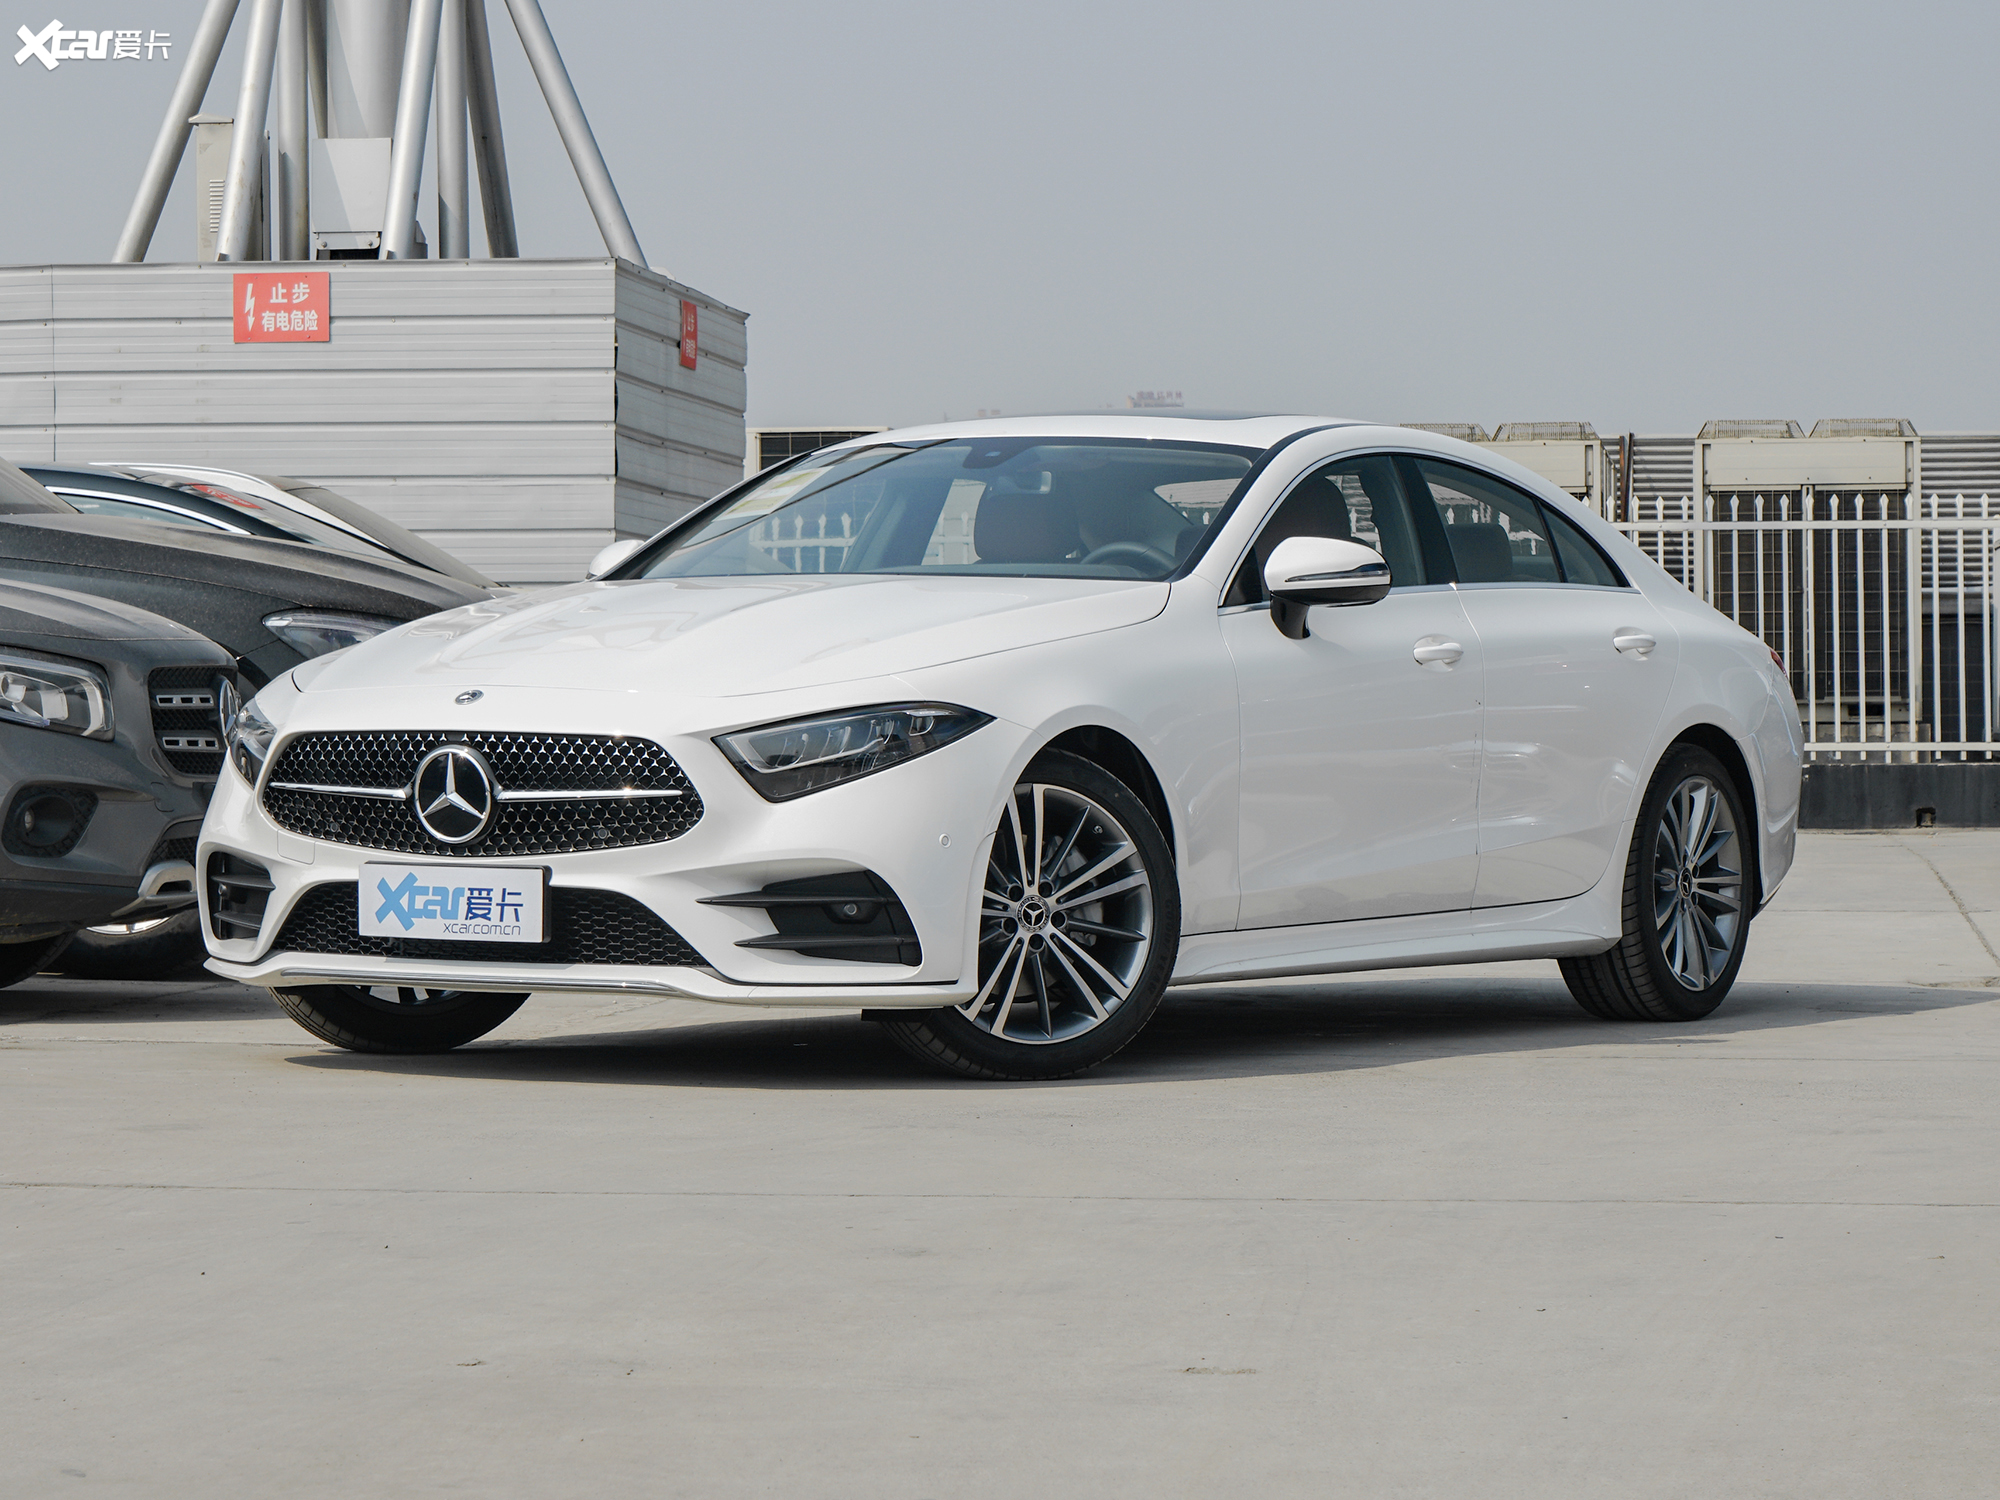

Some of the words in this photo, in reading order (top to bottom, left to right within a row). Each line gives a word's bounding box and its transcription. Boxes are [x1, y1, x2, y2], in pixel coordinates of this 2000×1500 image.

[269, 282, 310, 304] 止步
[261, 309, 318, 332] 有电危险
[443, 922, 521, 936] xcar.com.cn
